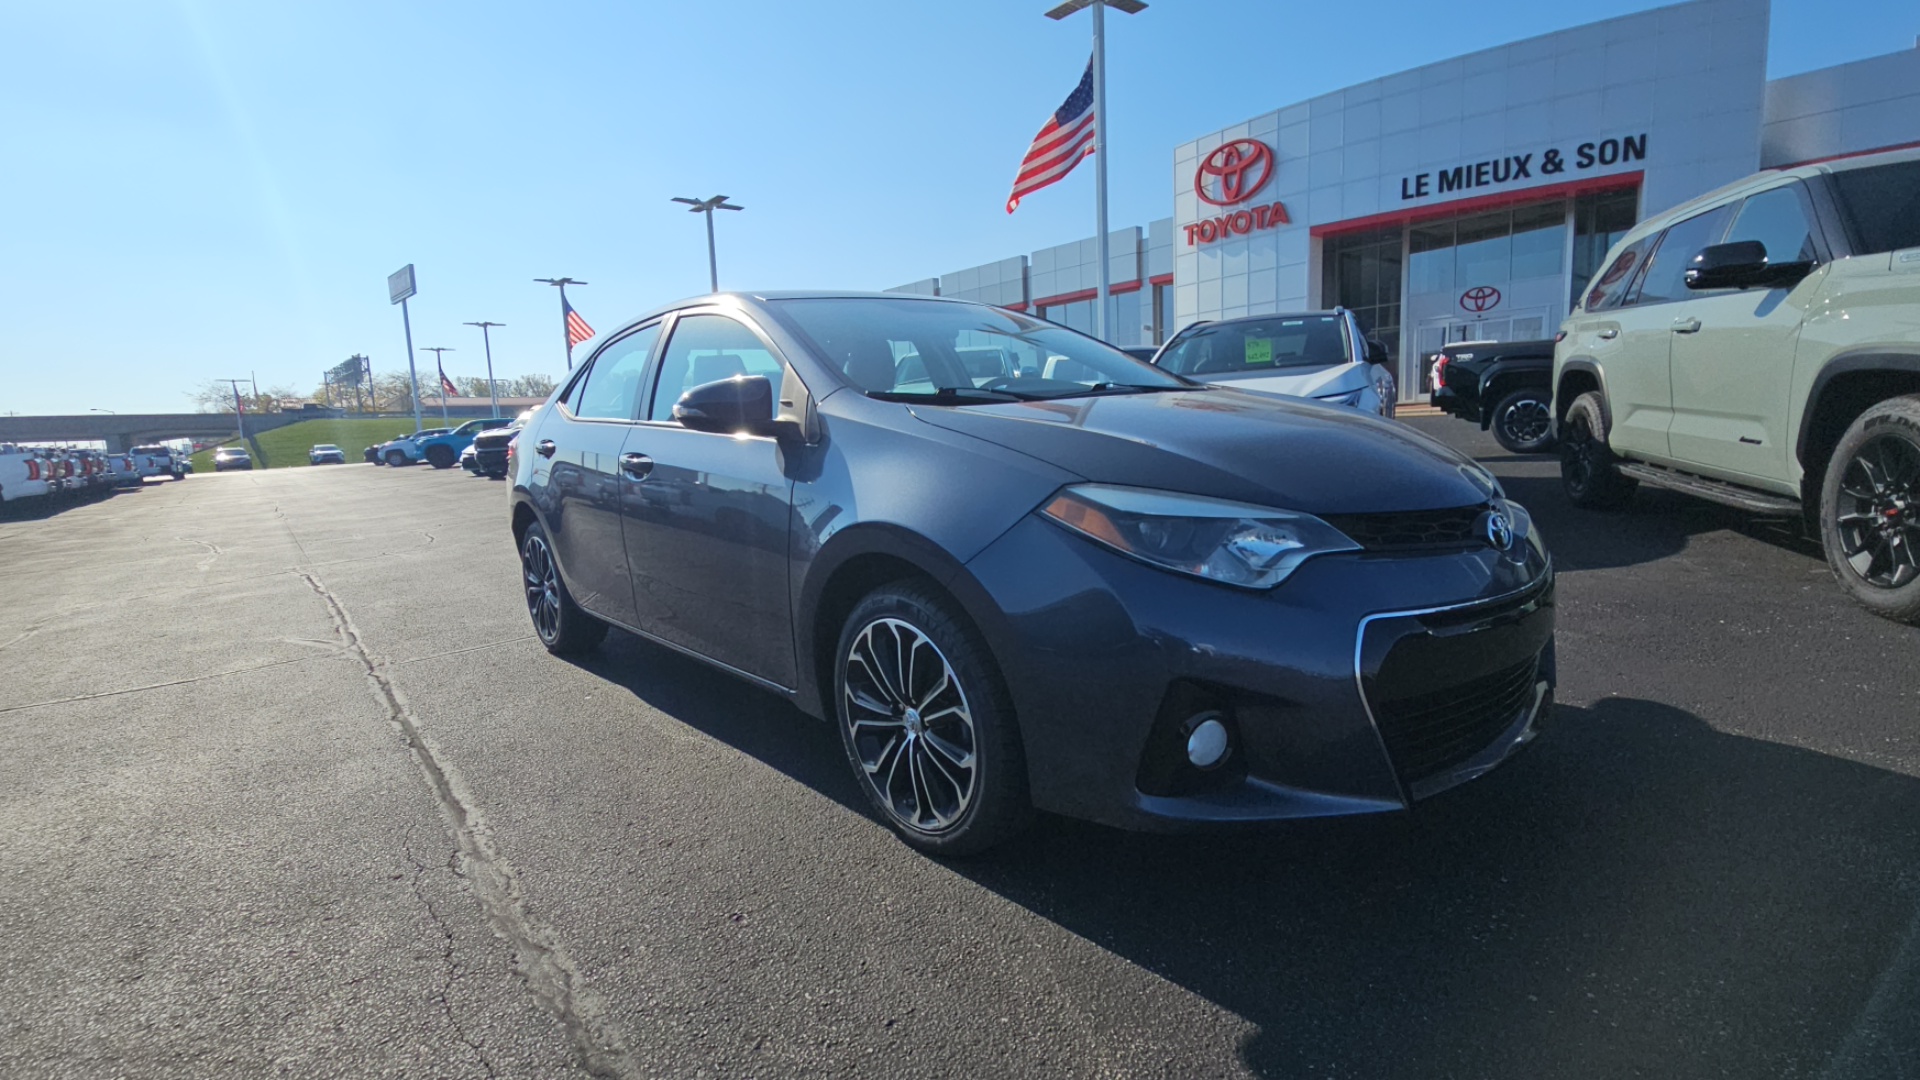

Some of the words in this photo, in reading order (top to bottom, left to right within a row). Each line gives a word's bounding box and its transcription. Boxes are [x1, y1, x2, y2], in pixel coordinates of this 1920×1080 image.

[1401, 173, 1430, 200] LE
[1438, 153, 1533, 194] MIEUX
[1541, 148, 1565, 174] &
[1576, 133, 1647, 170] SON
[1183, 201, 1290, 246] TOYOTA
